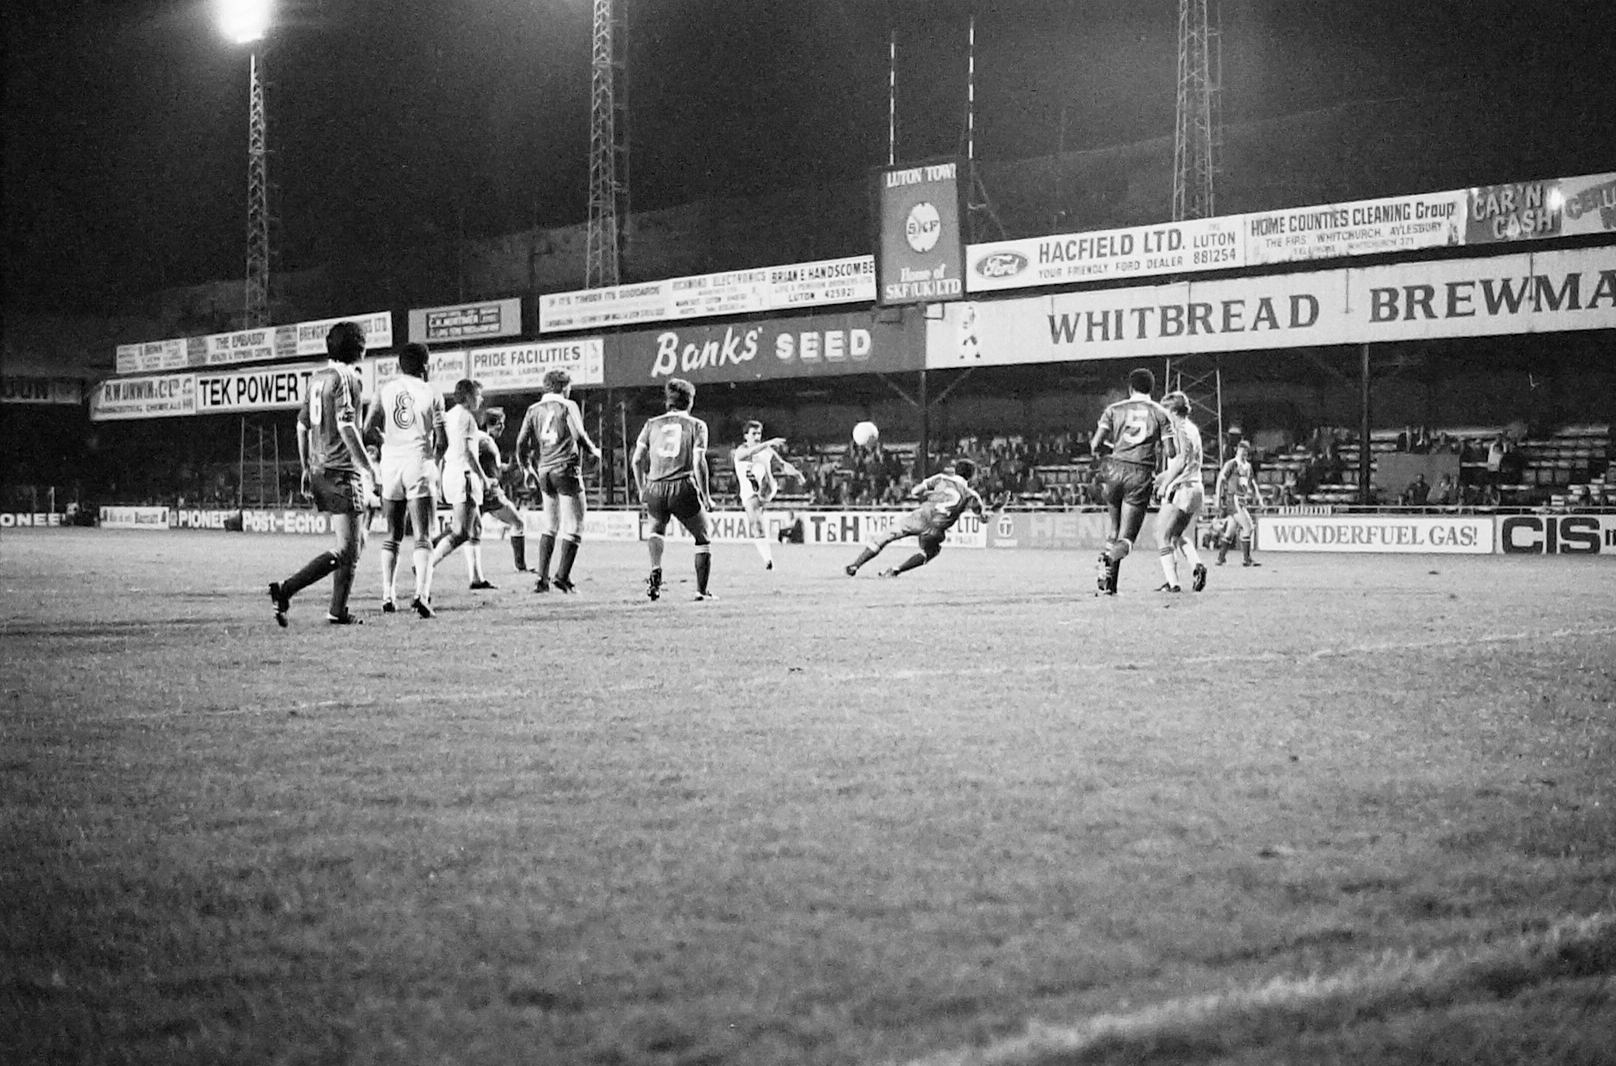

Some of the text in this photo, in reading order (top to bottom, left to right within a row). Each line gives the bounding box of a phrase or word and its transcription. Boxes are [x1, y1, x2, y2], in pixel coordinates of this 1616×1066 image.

[887, 163, 957, 188] LUTON TOWN
[1251, 201, 1456, 237] HOME COUNTIES CLEANING Group
[1493, 209, 1554, 240] CASH
[1039, 228, 1186, 264] HACFIELD LTD.
[1193, 231, 1236, 248] LUTON
[1265, 238, 1282, 247] THE
[1390, 222, 1442, 236] AYLESBURY
[983, 254, 1019, 278] Ford
[1039, 256, 1183, 279] YOUR FRIENDLY FORD DEALER
[1193, 248, 1236, 265] 881254
[772, 269, 798, 284] BRIAN
[809, 260, 874, 279] HANDSCOMBE
[1048, 269, 1616, 344] WHITBREAD BREWMA
[775, 328, 872, 360] SEED
[474, 352, 506, 368] PRIDE
[511, 346, 581, 365] FACILITIES
[200, 377, 232, 406] TEK
[237, 373, 299, 404] POWER
[394, 390, 415, 429] 8
[1122, 408, 1149, 445] 5
[658, 423, 683, 458] 3
[0, 513, 65, 527] ONEE
[178, 510, 232, 528] PIONEE
[242, 511, 326, 533] Post-Echo
[1273, 524, 1478, 547] WONDERFUEL GAS!
[1502, 517, 1601, 554] CIS
